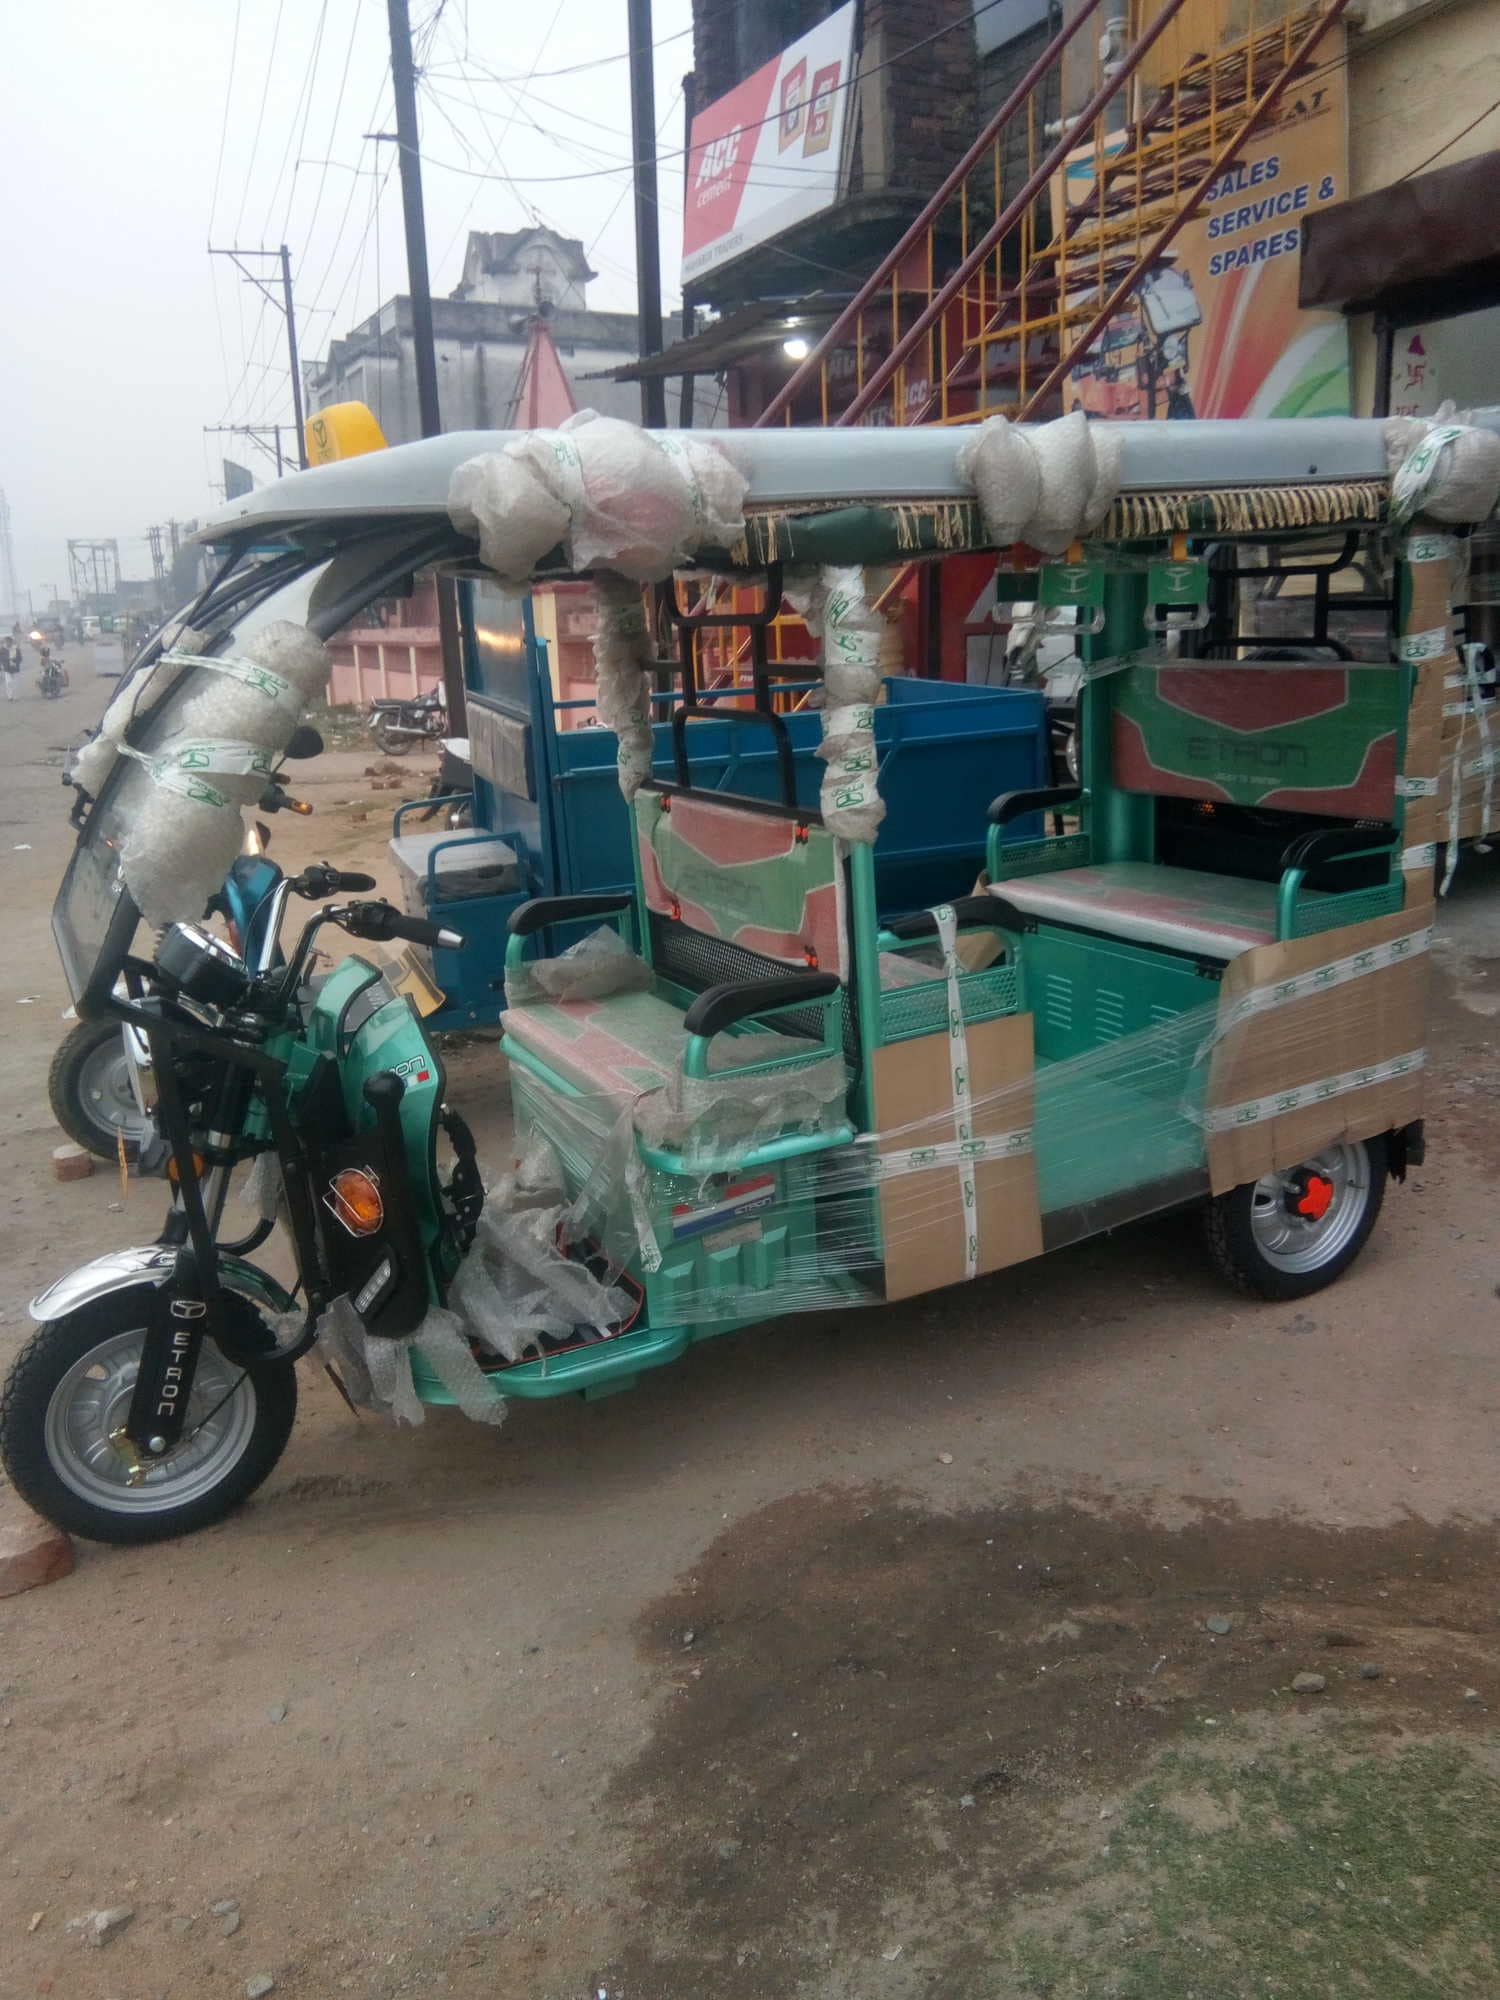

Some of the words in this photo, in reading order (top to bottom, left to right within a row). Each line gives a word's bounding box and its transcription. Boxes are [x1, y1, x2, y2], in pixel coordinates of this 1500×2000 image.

[695, 123, 743, 190] ACC
[1205, 156, 1281, 202] SALES
[697, 171, 733, 208] cement
[1207, 184, 1309, 239] SERVICE
[1317, 175, 1335, 201] &
[1209, 228, 1299, 276] SPARES
[157, 1331, 191, 1416] ETRON
